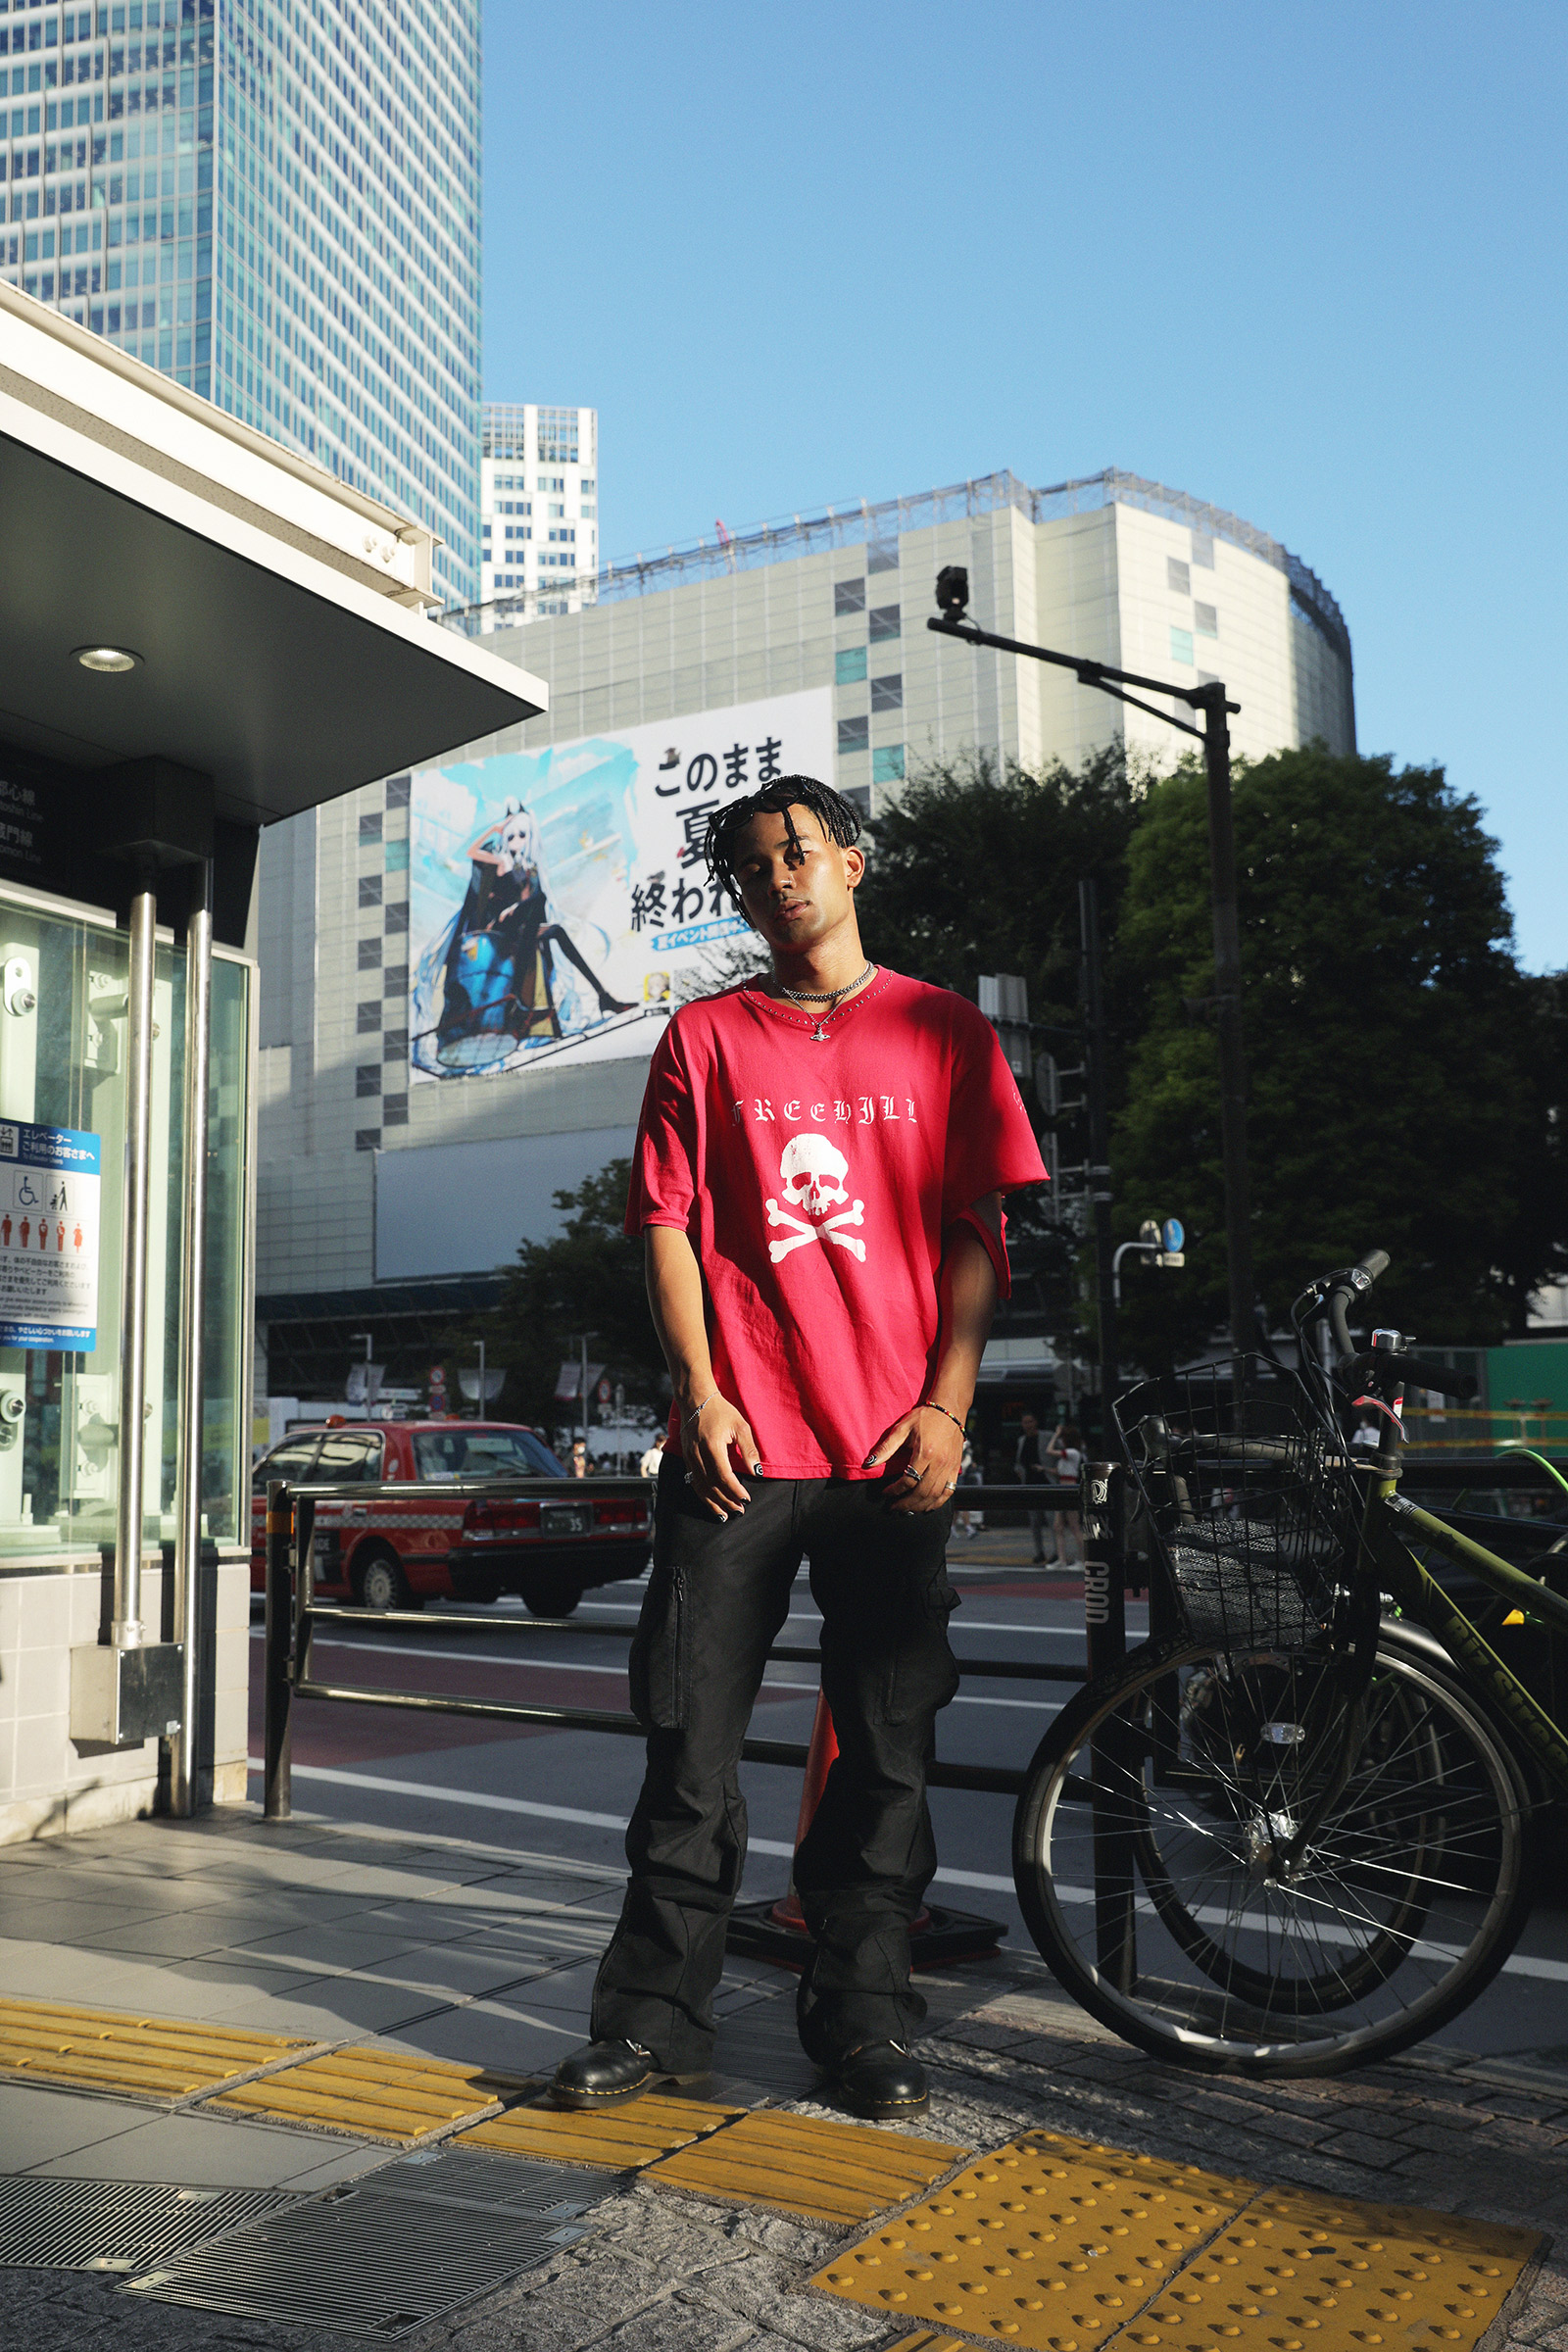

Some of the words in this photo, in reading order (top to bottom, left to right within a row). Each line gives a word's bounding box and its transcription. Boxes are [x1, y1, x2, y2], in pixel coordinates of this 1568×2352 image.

[654, 735, 783, 798] このまま
[23, 1129, 73, 1145] エレベーター
[22, 1141, 95, 1160] ご利用のお客さまへ
